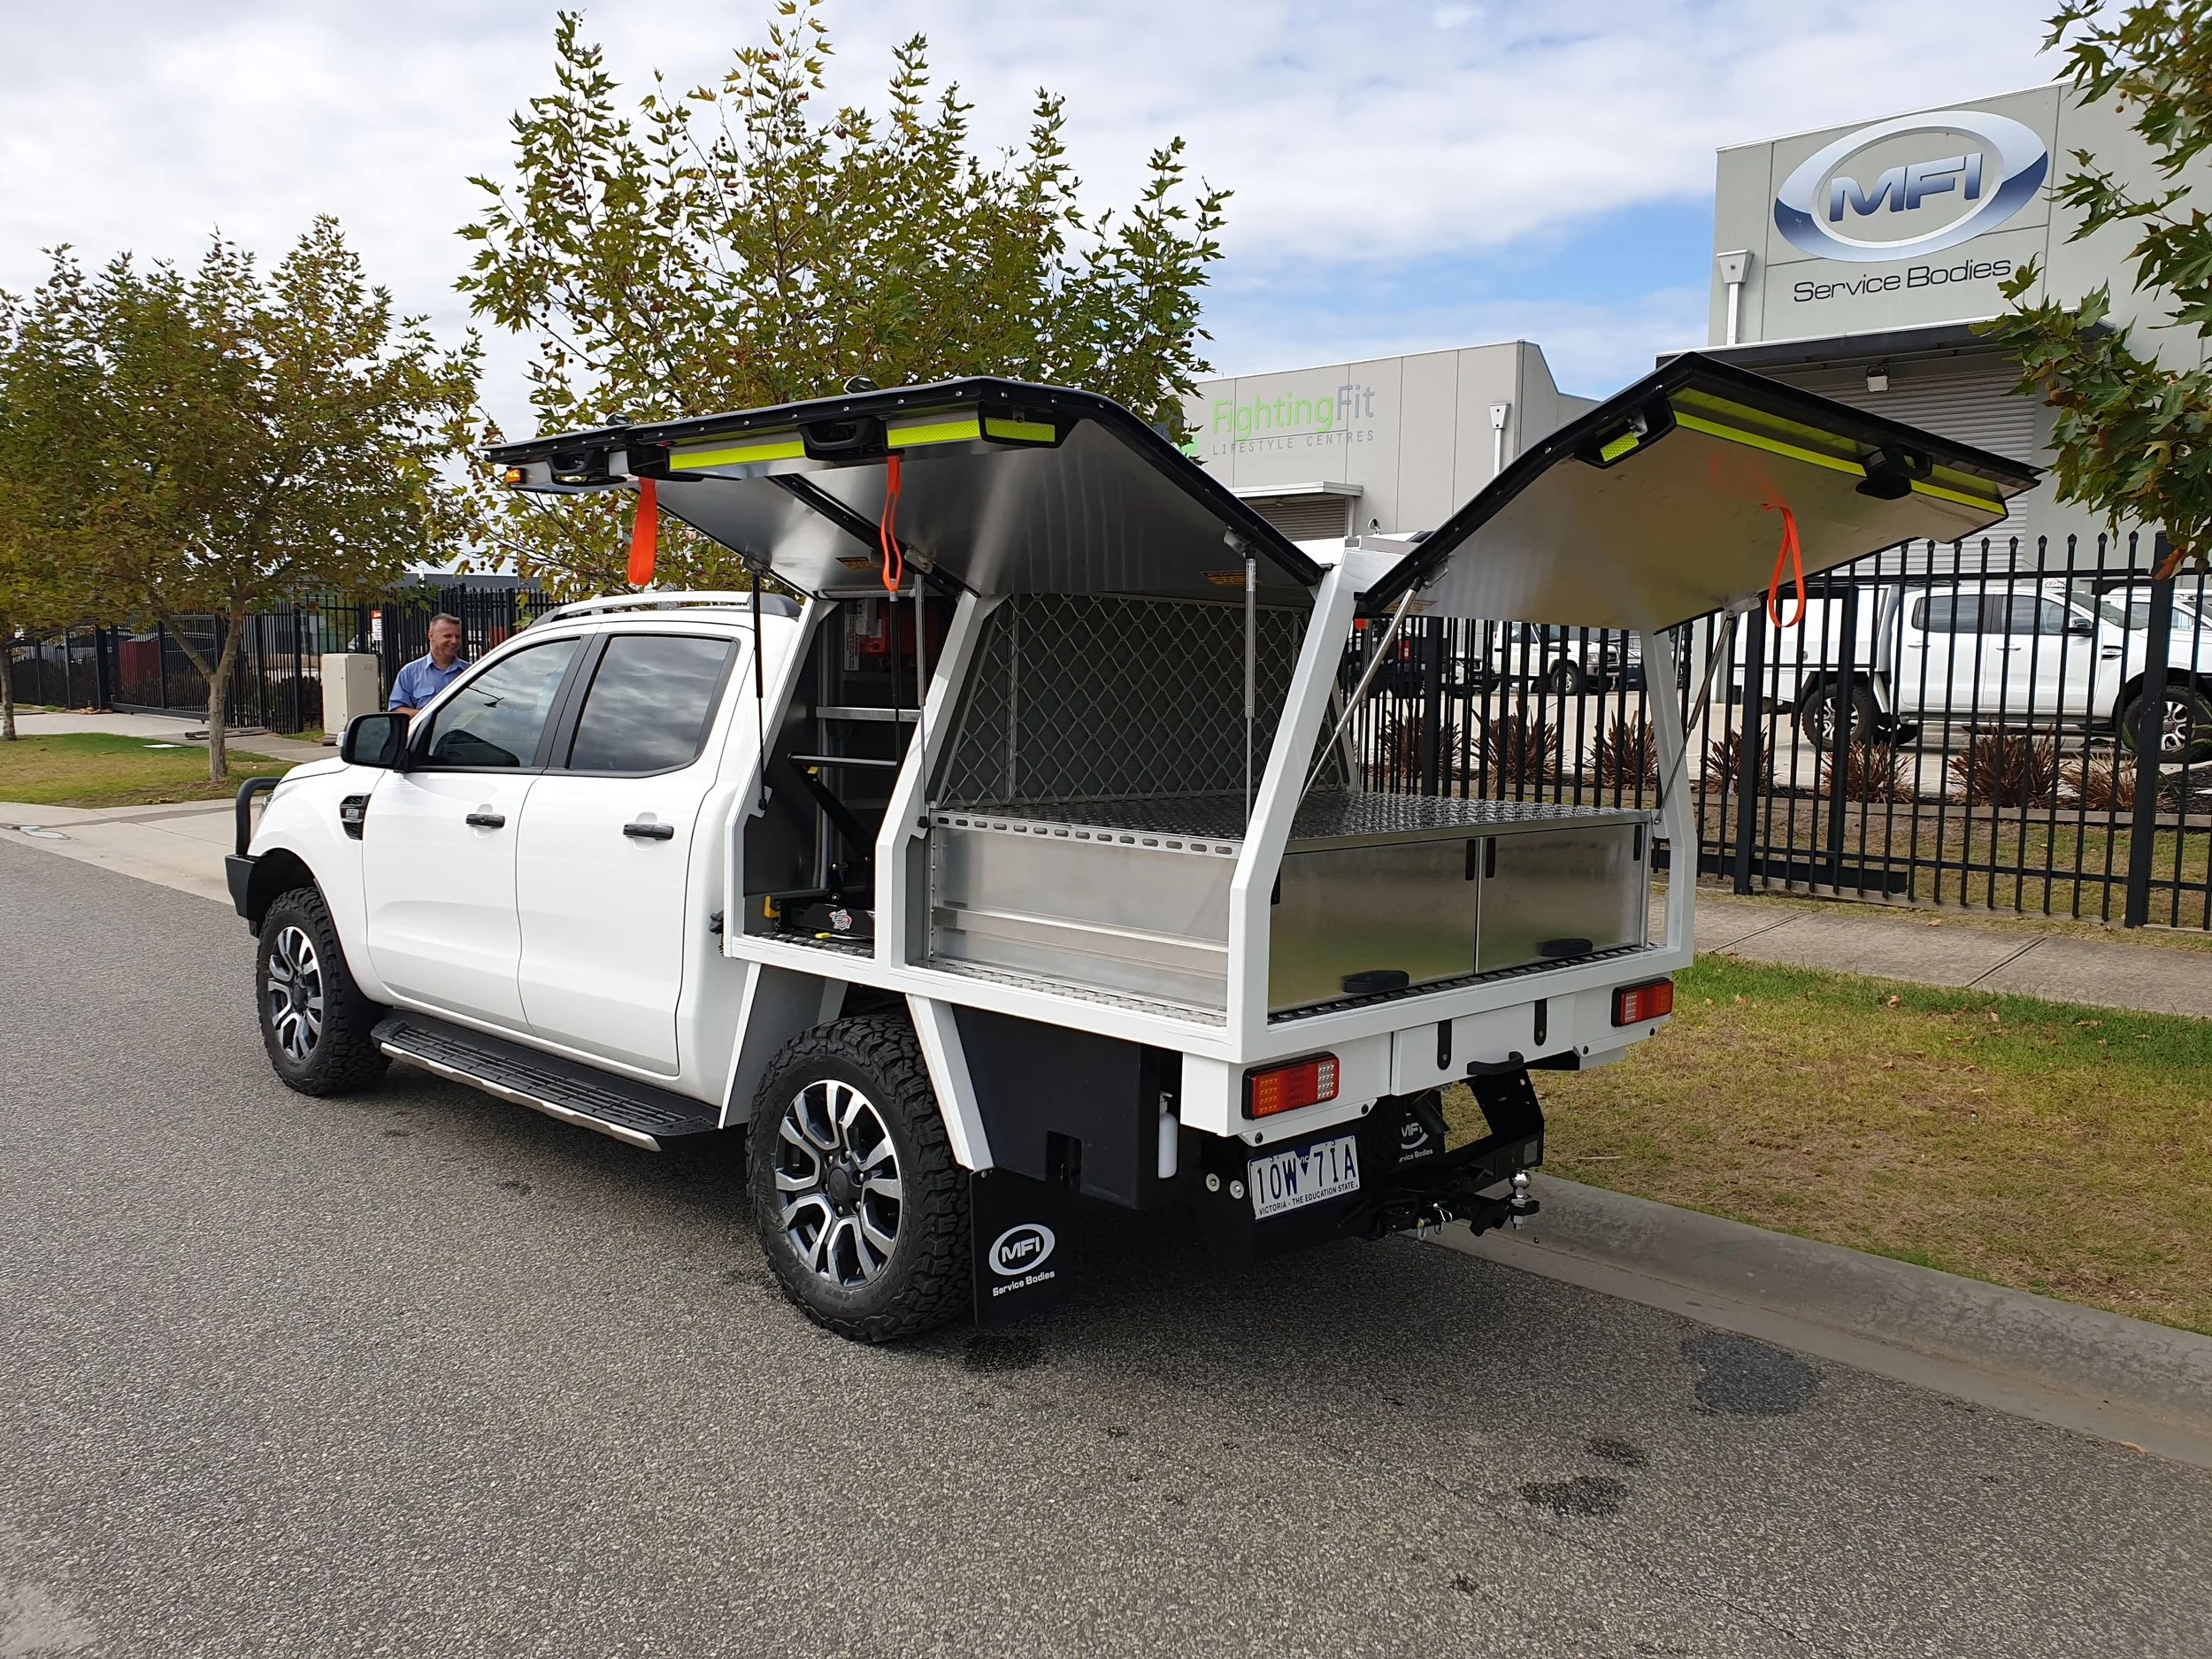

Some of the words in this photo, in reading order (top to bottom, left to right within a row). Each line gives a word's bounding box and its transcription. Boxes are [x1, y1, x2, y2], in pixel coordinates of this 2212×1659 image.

[1830, 153, 1983, 221] MFI
[1793, 273, 1901, 303] Service
[1907, 259, 2011, 288] Bodies
[1212, 384, 1375, 442] FightingFit
[1213, 436, 1294, 456] LIFESTYLE
[1306, 430, 1374, 447] CENTRES
[1258, 1201, 1287, 1216] VICTORIA
[1292, 1194, 1303, 1206] THE
[1305, 1186, 1337, 1202] EDUCATION
[1338, 1180, 1355, 1193] STATE
[1002, 1237, 1040, 1263] MFI
[993, 1280, 1024, 1296] Service
[1025, 1271, 1055, 1285] Bodies
